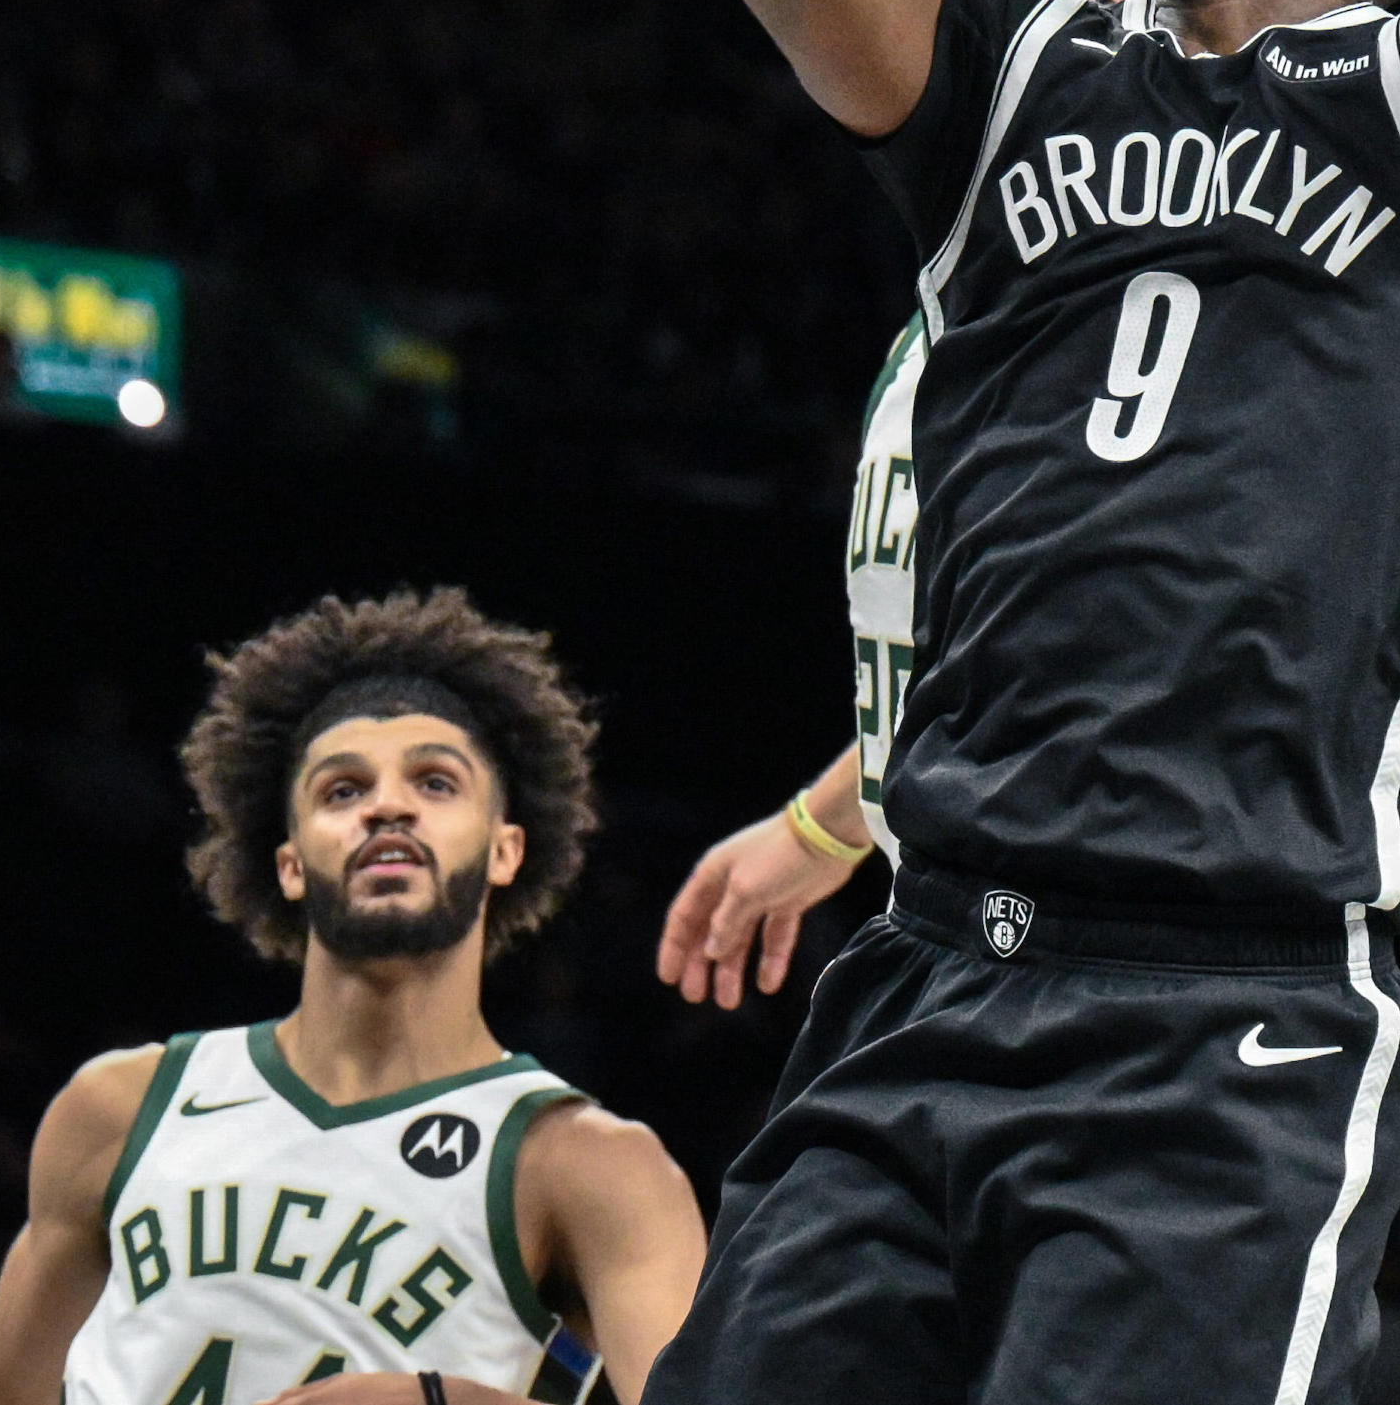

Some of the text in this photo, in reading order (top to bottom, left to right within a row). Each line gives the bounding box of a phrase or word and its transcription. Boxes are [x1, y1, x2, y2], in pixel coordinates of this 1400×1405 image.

[1265, 45, 1370, 80] All In Won
[1000, 124, 1396, 277] BROOKLYN
[1085, 271, 1201, 462] 9
[987, 896, 1027, 924] NETS
[119, 1184, 475, 1349] BUCKS
